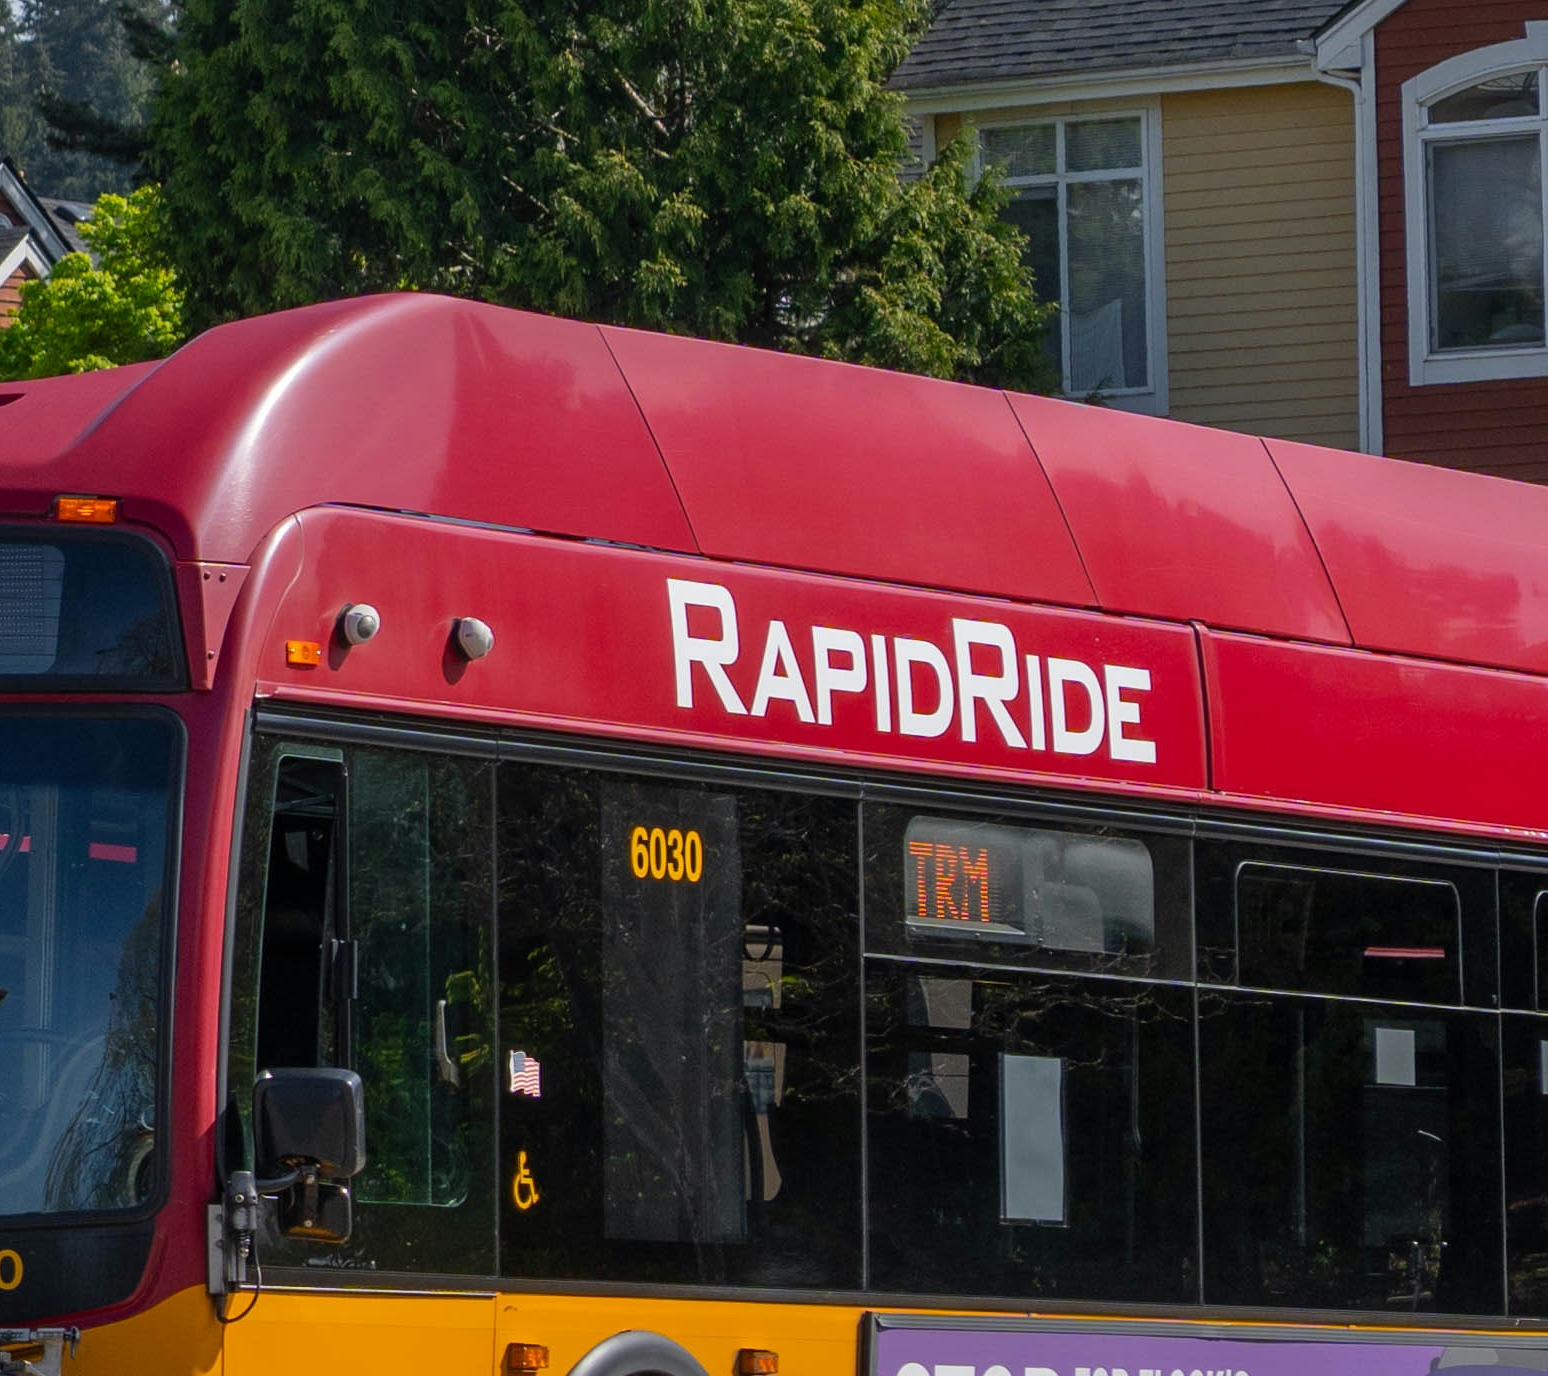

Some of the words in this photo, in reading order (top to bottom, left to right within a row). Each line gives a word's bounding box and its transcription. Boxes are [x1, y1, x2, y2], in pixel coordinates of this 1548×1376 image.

[666, 577, 1157, 764] RAPIDRIDE
[630, 825, 704, 884] 6030
[907, 840, 990, 923] TRM
